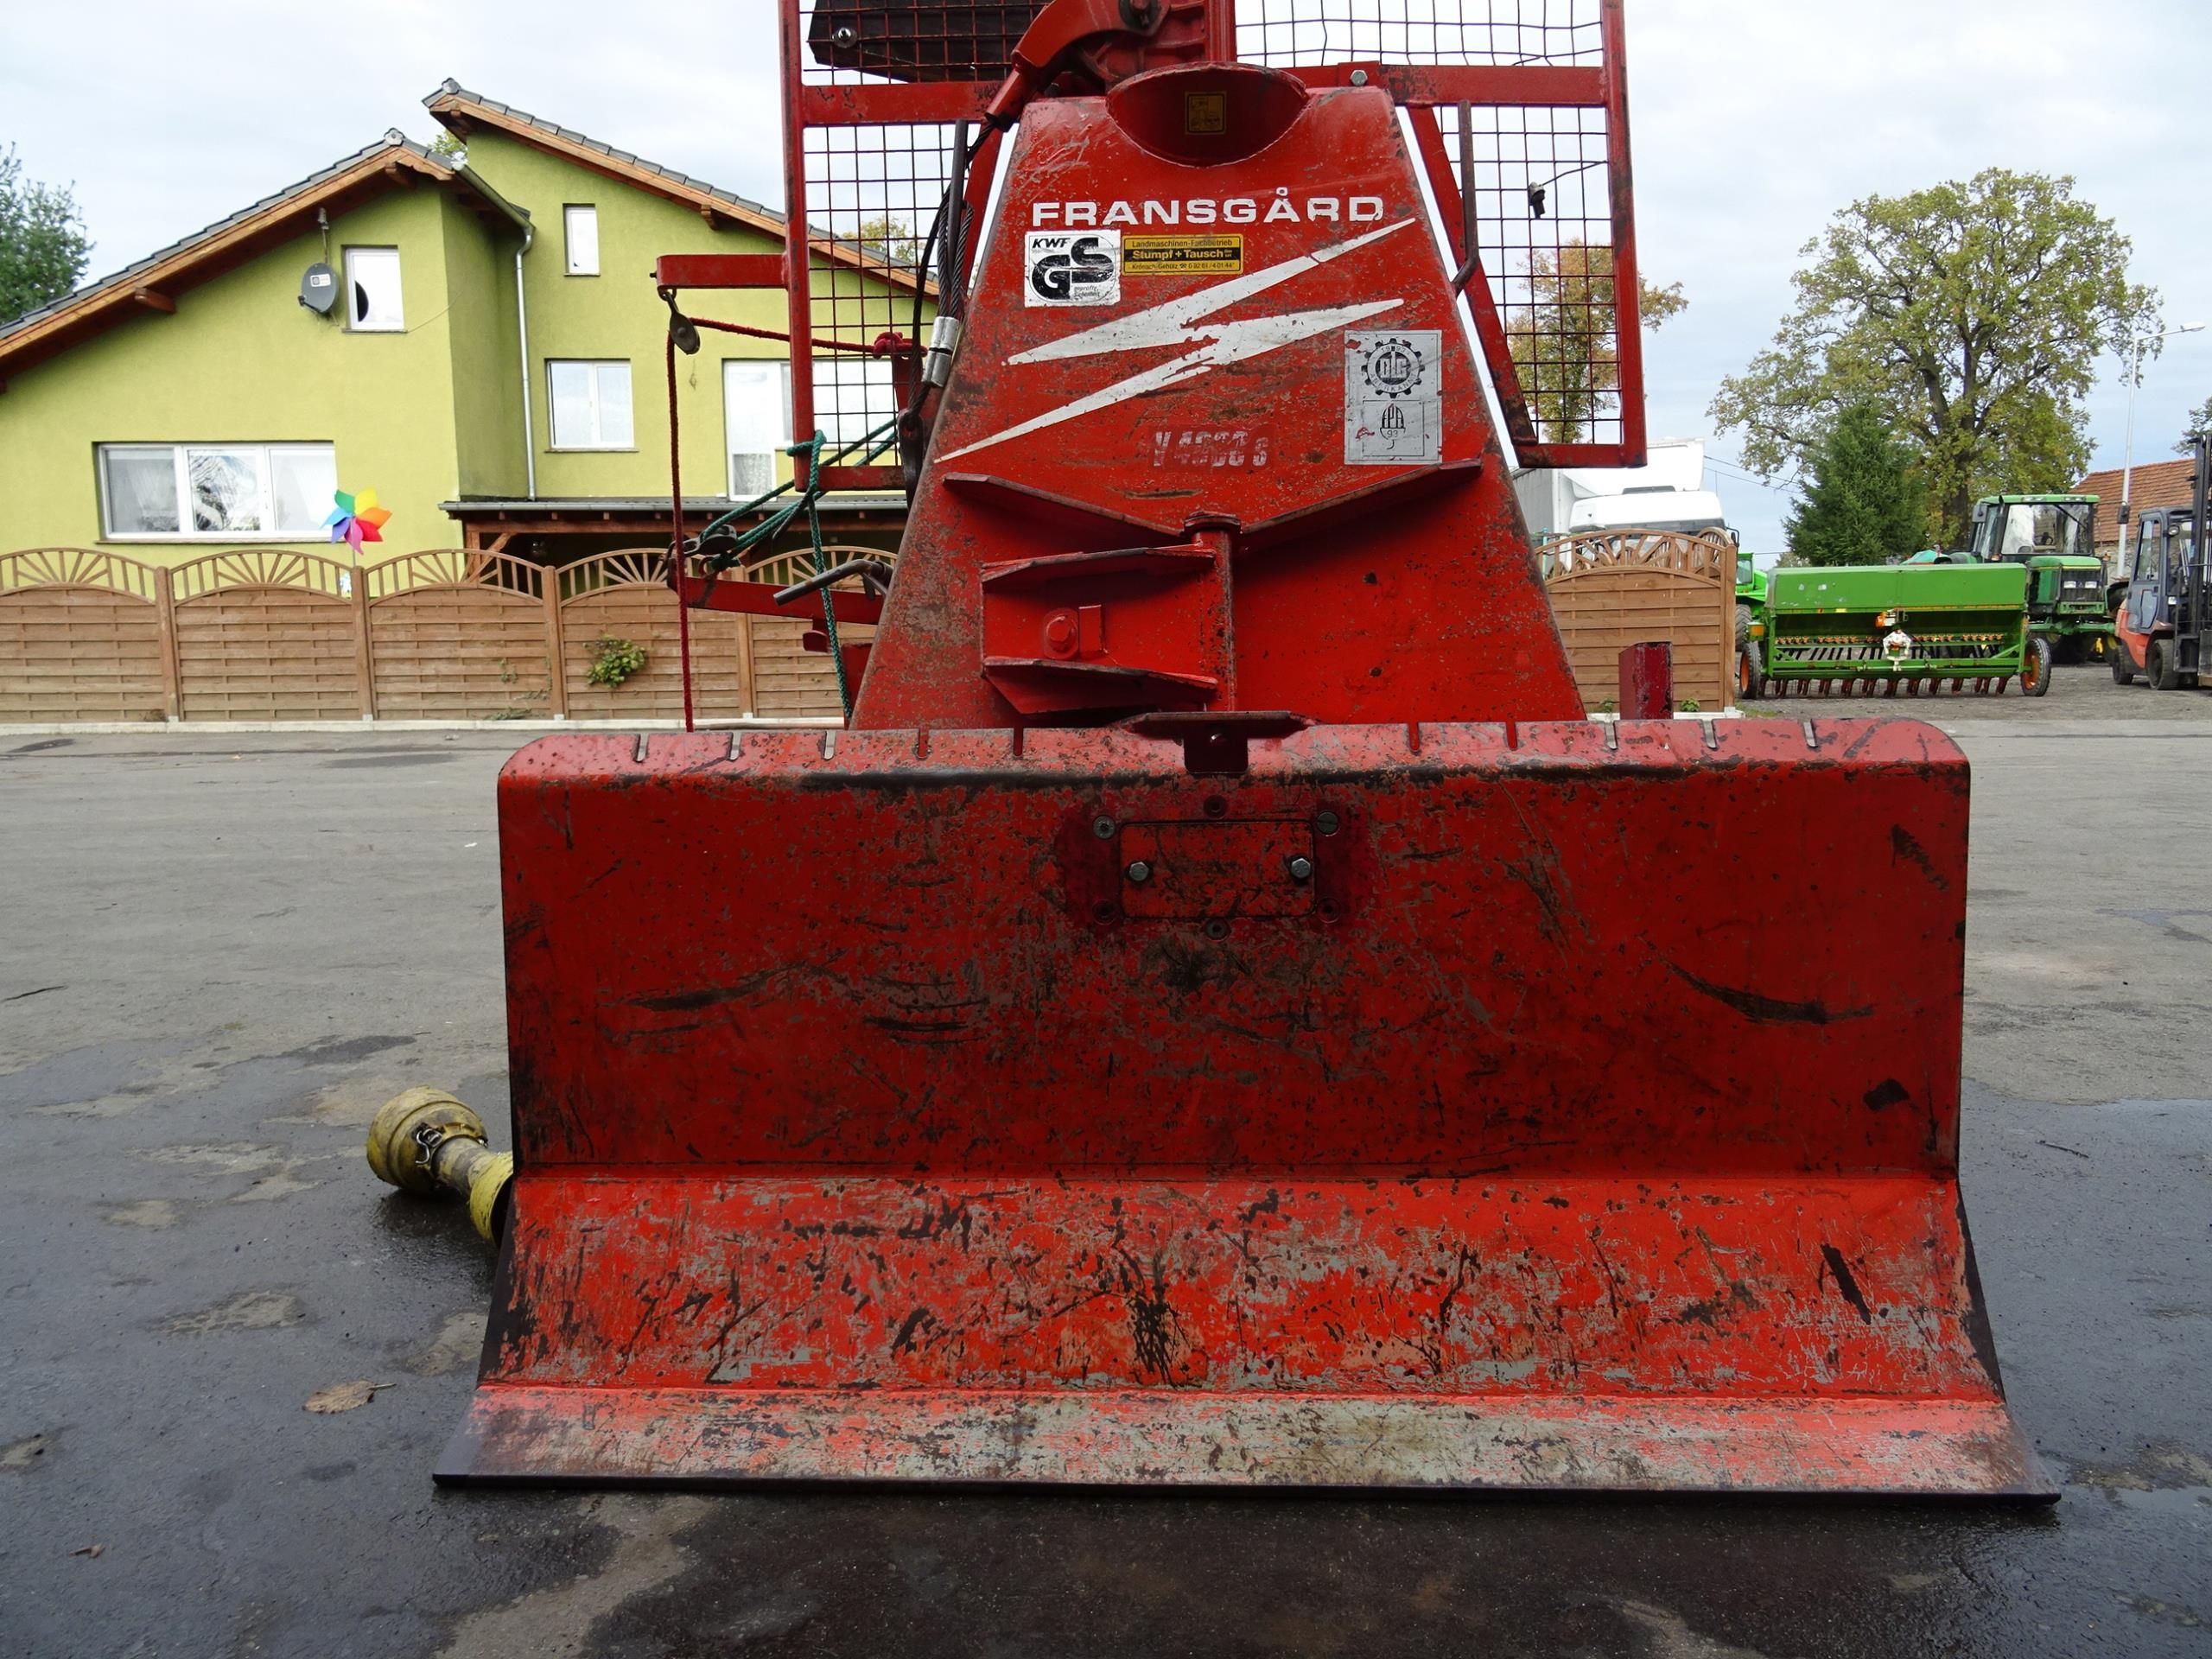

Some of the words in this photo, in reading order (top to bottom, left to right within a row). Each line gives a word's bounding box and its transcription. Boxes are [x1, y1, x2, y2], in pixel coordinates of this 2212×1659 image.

[1032, 187, 1384, 226] FRANSGÅRD
[1033, 238, 1071, 248] KWF
[1133, 249, 1173, 260] Stumpf
[1184, 248, 1224, 259] Tausch
